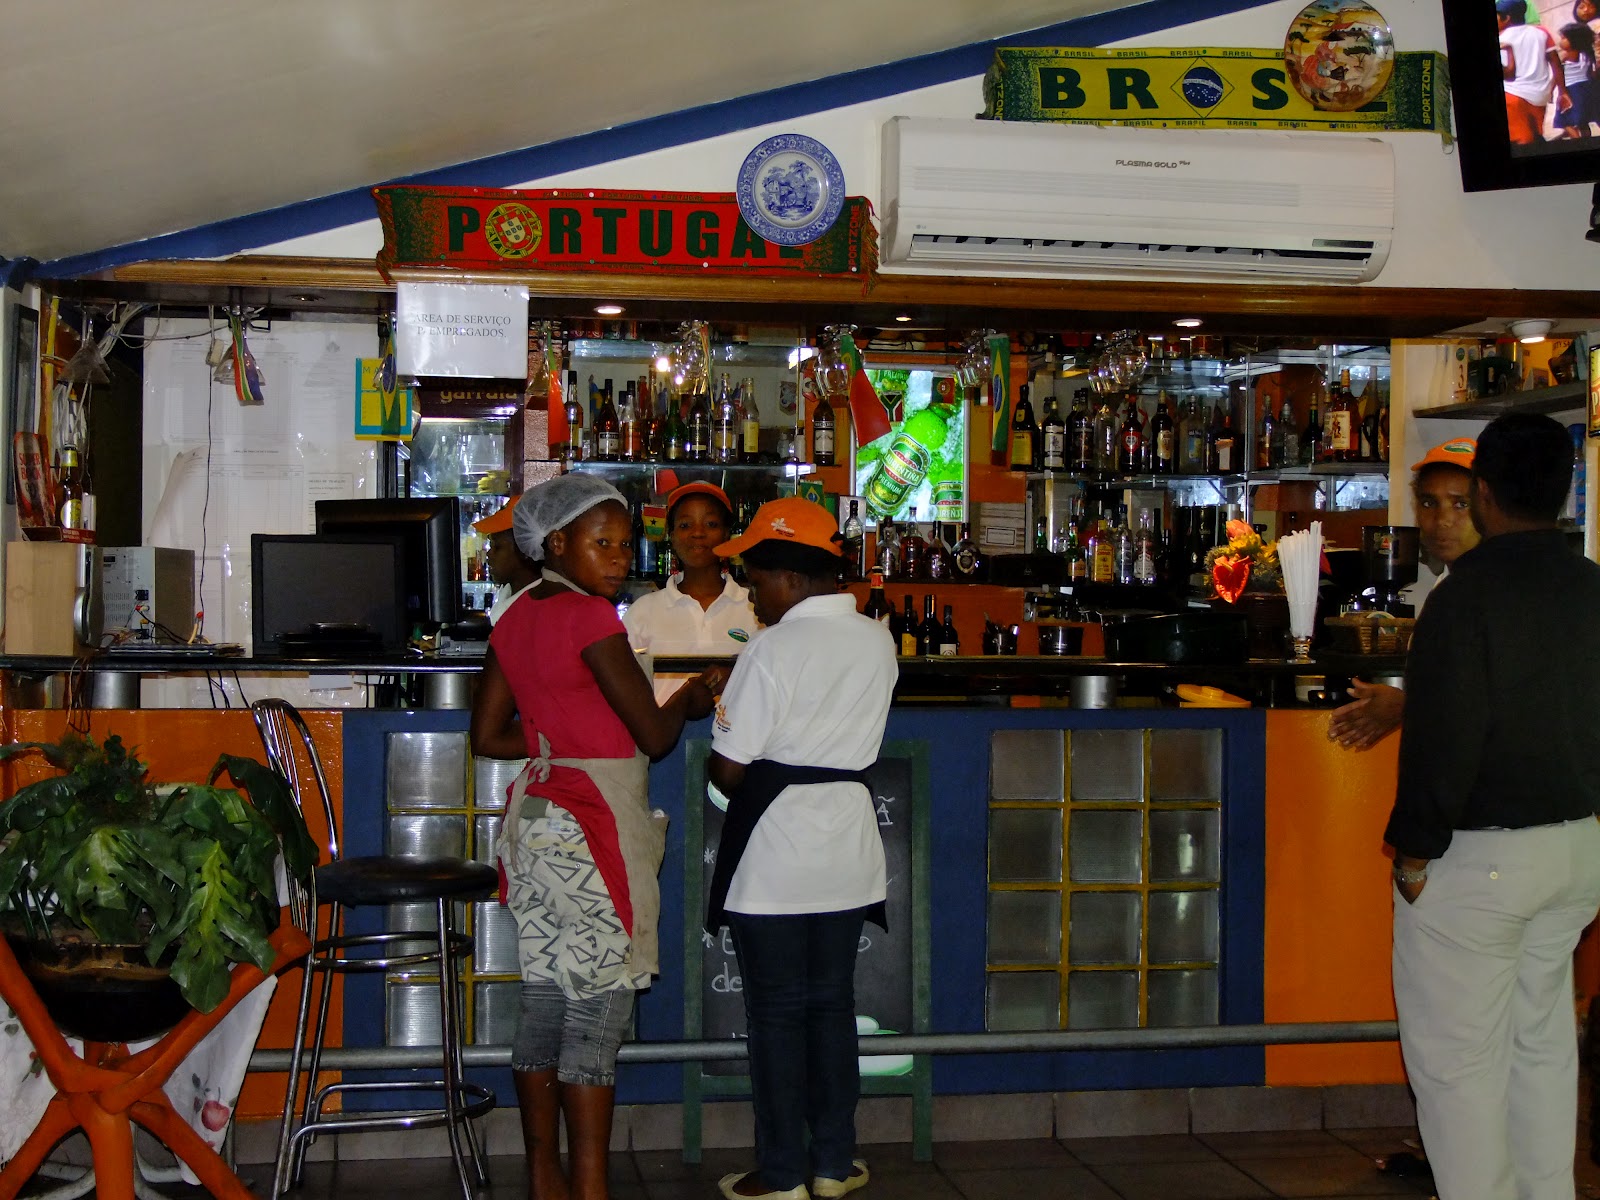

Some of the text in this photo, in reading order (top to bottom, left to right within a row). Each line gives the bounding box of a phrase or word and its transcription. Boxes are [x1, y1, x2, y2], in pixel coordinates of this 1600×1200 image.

[1038, 66, 1388, 113] BRS
[1421, 59, 1432, 125] SPORTZONE
[1115, 159, 1153, 168] PLASMA
[1154, 161, 1178, 169] GOLD
[448, 205, 804, 259] PRTUGA
[446, 314, 463, 324] DE
[464, 315, 512, 327] SERVIÇO
[877, 473, 902, 495] PREMIUM
